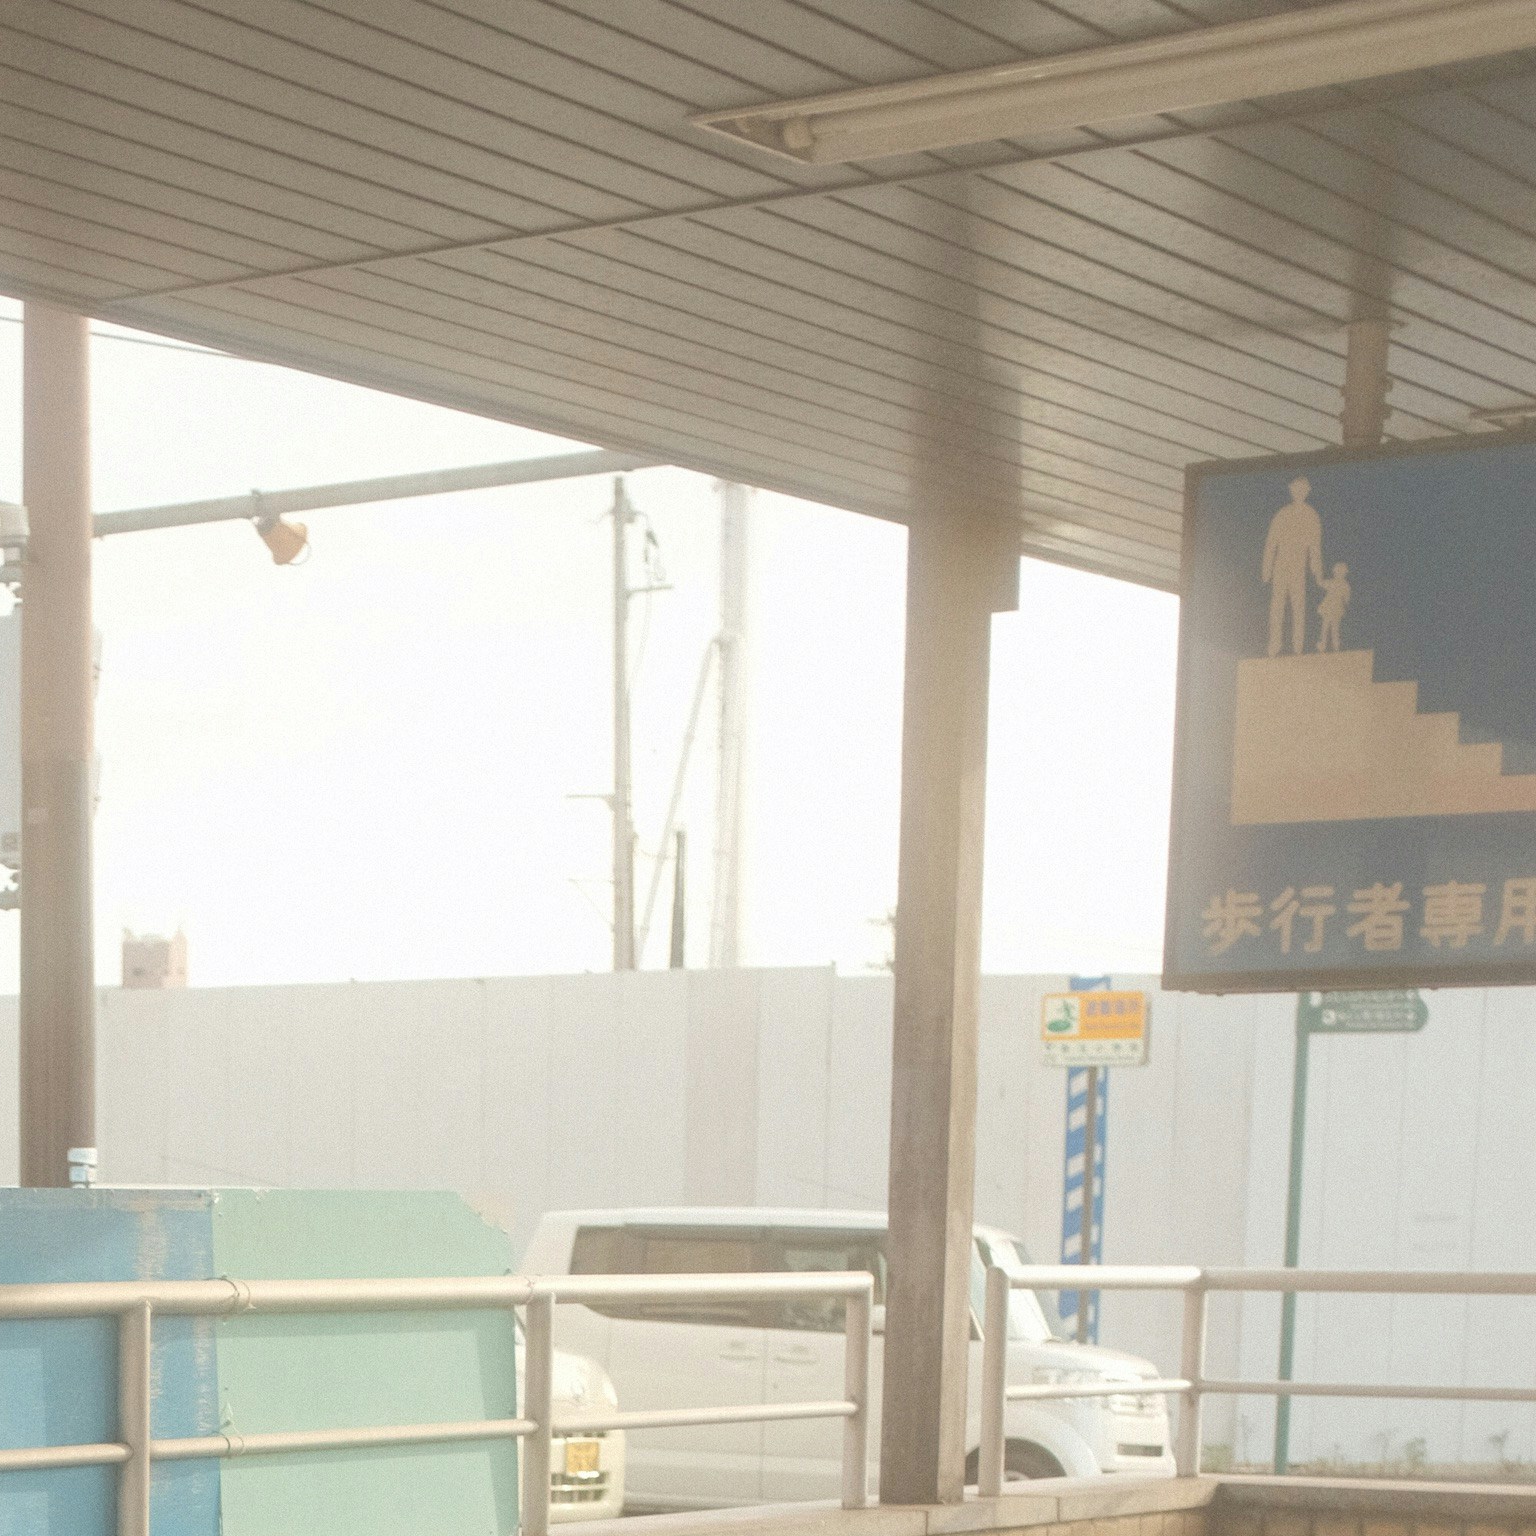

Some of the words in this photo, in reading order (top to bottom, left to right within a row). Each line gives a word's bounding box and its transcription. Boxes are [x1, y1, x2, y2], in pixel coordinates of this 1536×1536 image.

[1201, 877, 1536, 957] 歩行者専用
